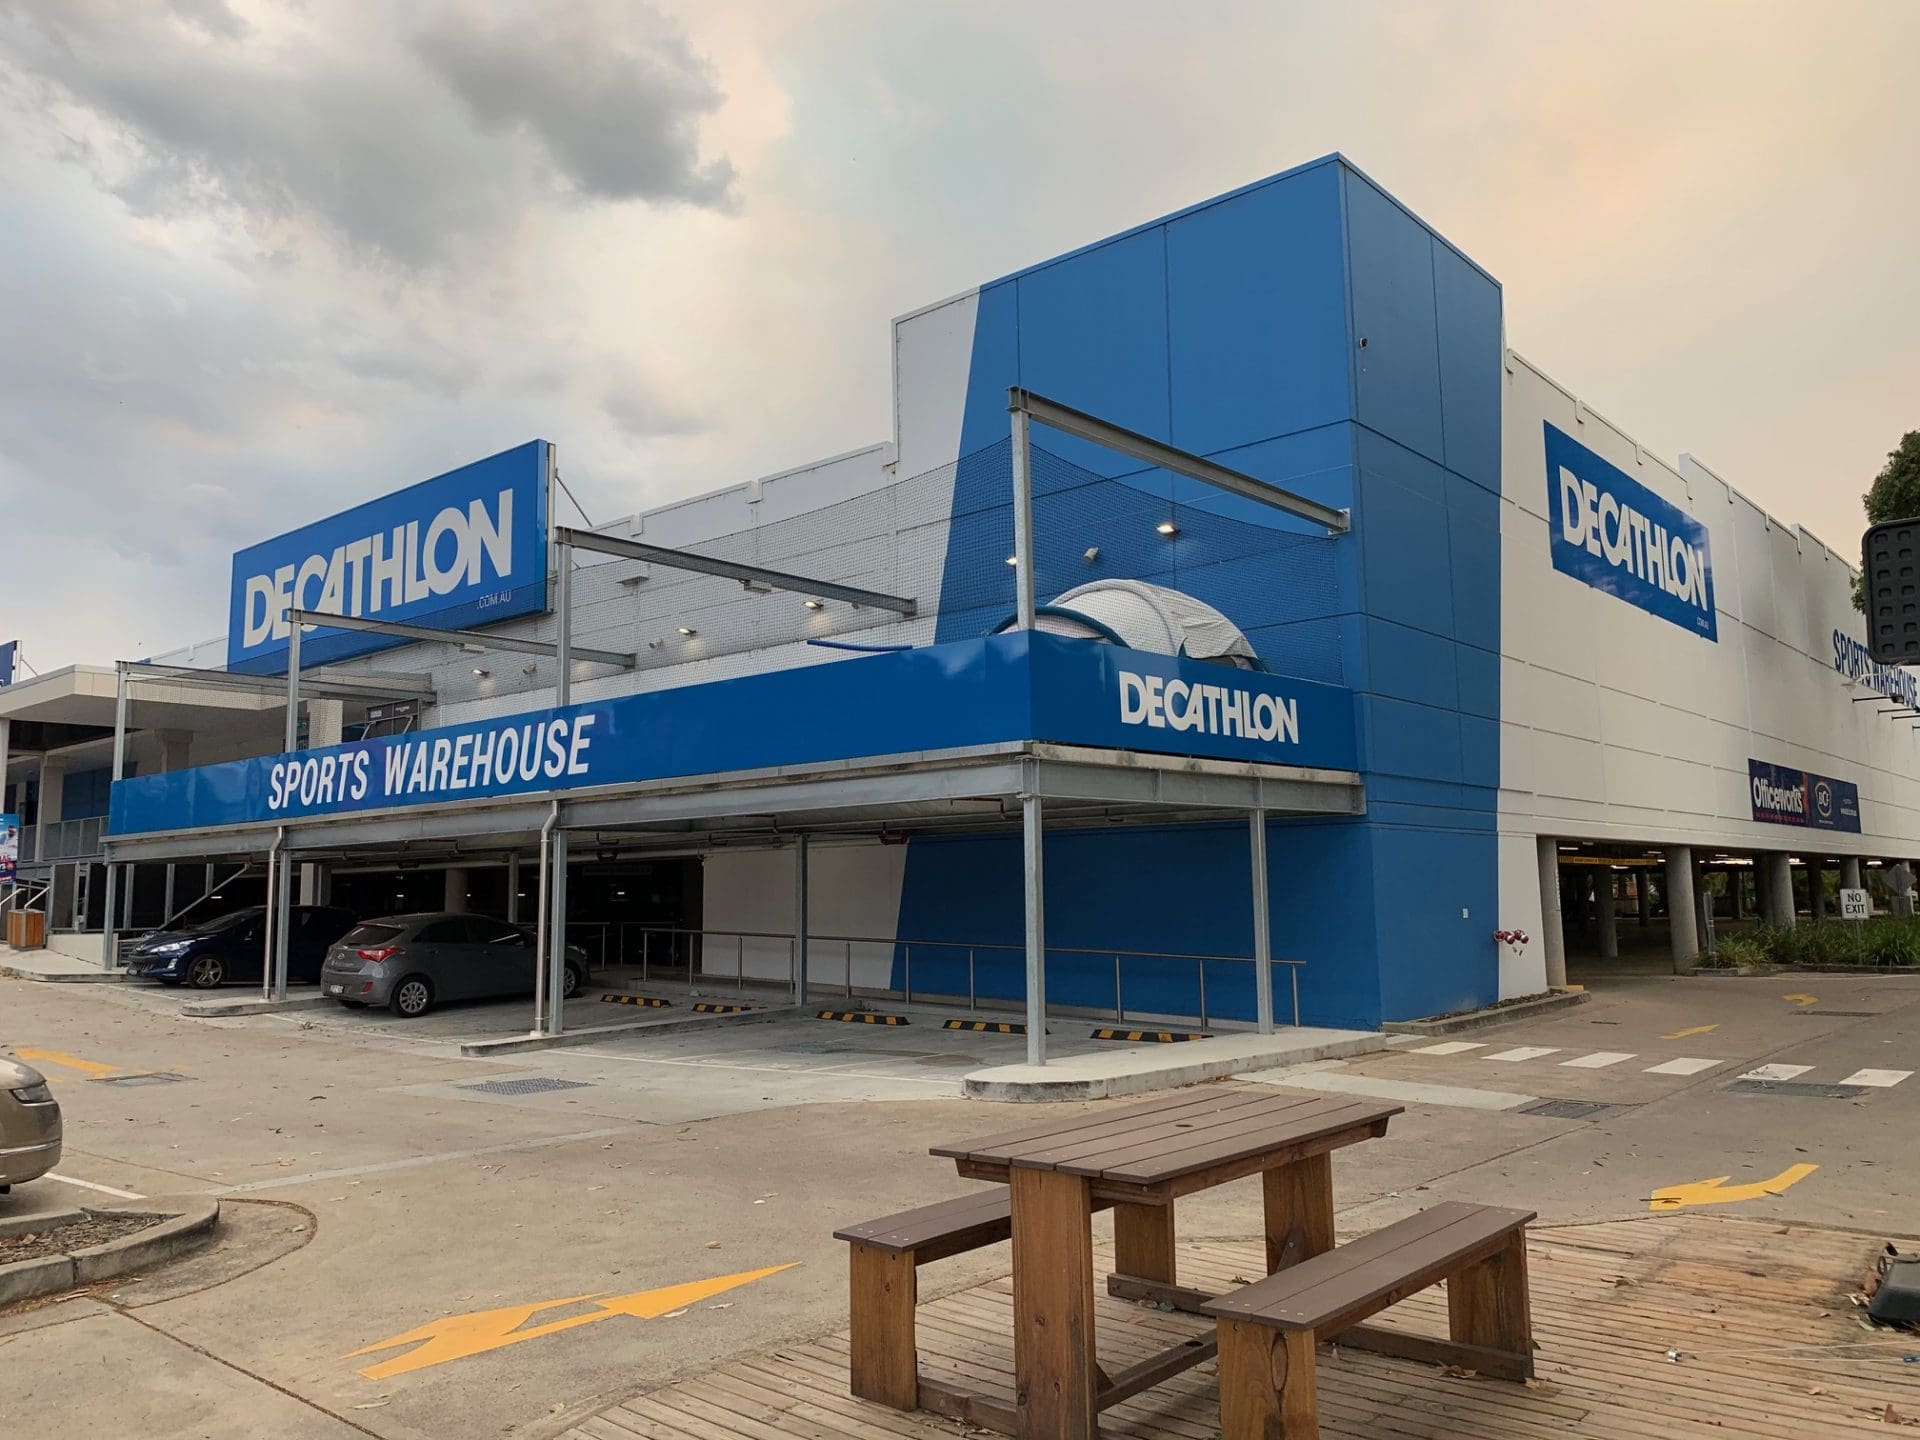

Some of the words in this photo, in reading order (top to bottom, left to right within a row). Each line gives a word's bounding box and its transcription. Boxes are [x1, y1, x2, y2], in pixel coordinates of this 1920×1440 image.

[243, 488, 513, 648] DECATHLON
[1559, 465, 1708, 612] DECATHLON
[1833, 629, 1871, 687] SPORTS
[1119, 671, 1299, 744] DECATHLON
[268, 750, 369, 810] SPORTS
[384, 714, 595, 797] WAREHOUSE
[1753, 777, 1803, 813] Officeworks
[1845, 904, 1865, 914] EXIT
[1847, 892, 1862, 903] NO
